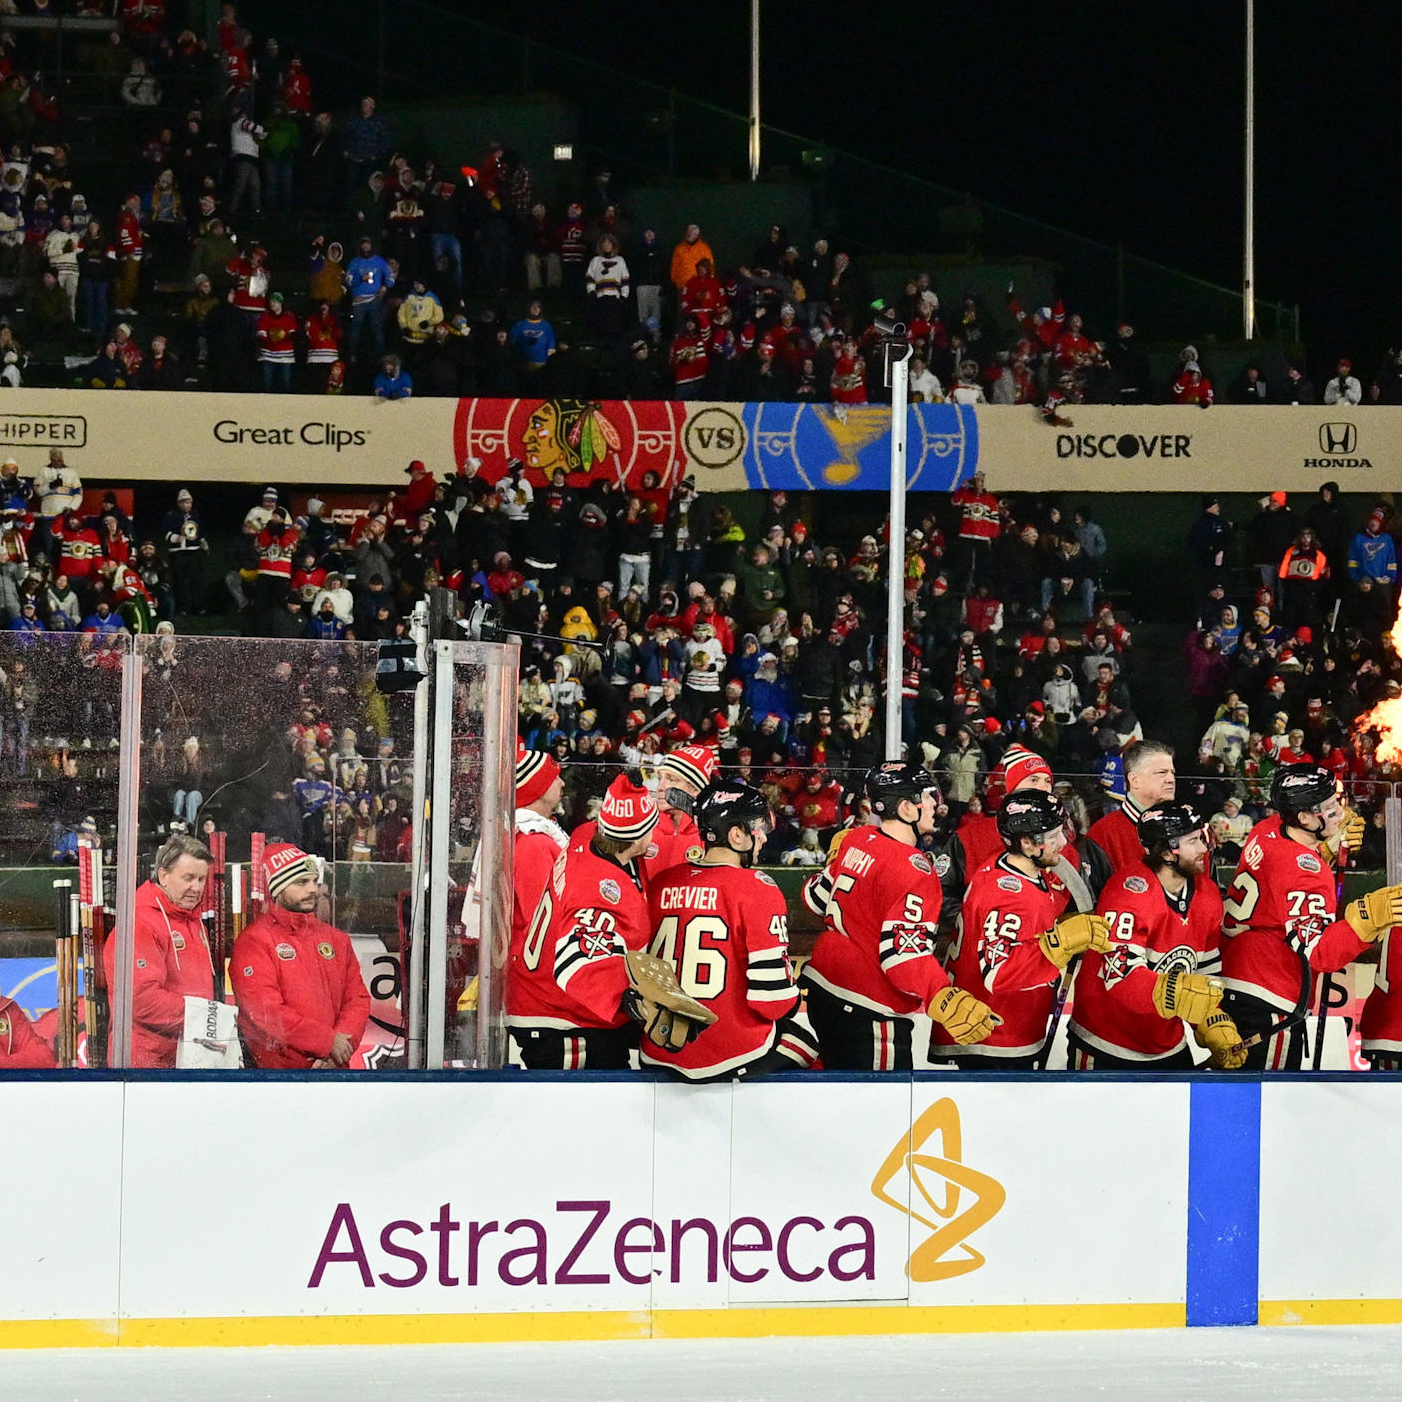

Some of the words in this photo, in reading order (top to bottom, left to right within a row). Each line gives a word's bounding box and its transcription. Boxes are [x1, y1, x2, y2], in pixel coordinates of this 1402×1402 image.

[214, 421, 292, 446] Great
[300, 422, 366, 452] Clips
[697, 427, 734, 449] VS
[1056, 433, 1191, 459] DISCOVER
[1303, 458, 1373, 469] HONDA
[661, 885, 718, 911] CREVIER
[904, 893, 924, 923] 5
[1287, 890, 1326, 917] 72
[982, 910, 1023, 941] 42
[648, 914, 729, 1000] 46
[306, 1200, 876, 1289] AstraZeneca
